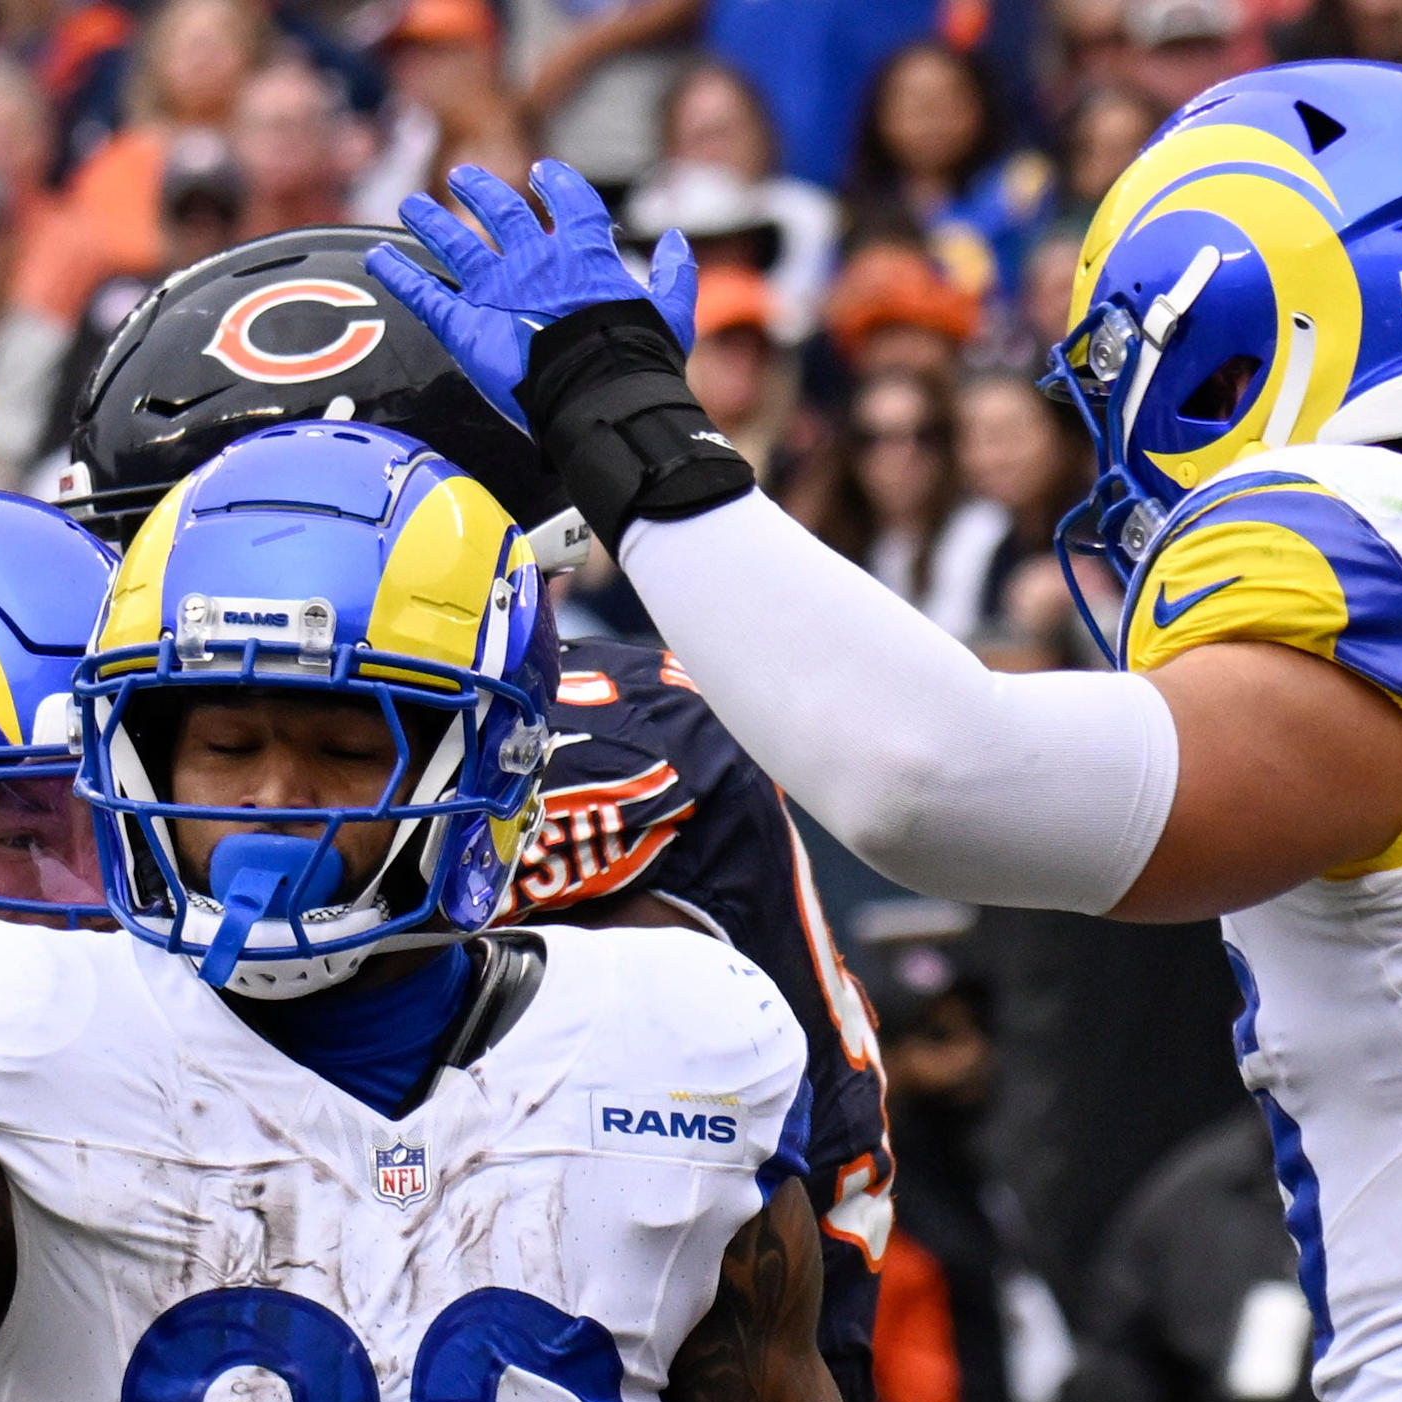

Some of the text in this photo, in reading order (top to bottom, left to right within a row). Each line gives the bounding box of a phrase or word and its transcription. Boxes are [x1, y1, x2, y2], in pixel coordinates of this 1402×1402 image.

[203, 279, 386, 384] C
[223, 610, 290, 628] RAMS
[601, 1106, 739, 1145] RAMS
[380, 1167, 425, 1197] NFL
